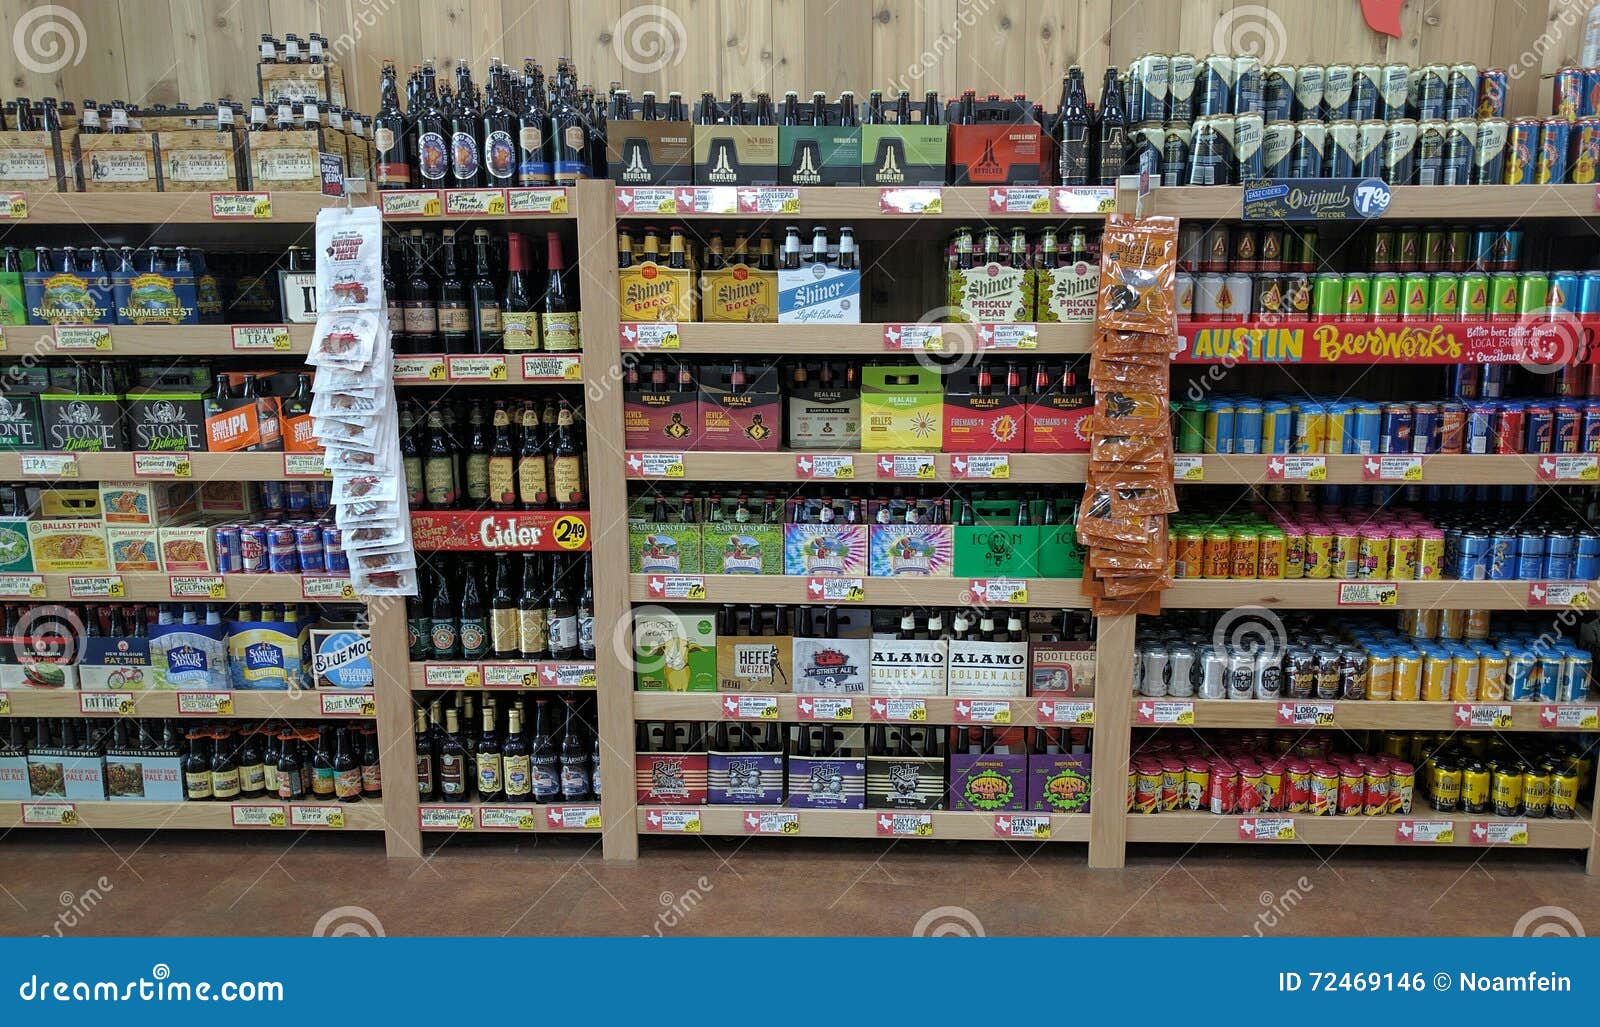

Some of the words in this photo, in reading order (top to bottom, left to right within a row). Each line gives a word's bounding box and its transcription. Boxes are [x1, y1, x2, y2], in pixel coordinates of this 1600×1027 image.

[321, 164, 340, 173] BACON
[325, 172, 343, 185] JERKY
[1284, 185, 1350, 214] Original
[215, 204, 236, 216] Ginger
[626, 280, 674, 304] Shiner
[718, 280, 764, 304] Shiner
[967, 276, 1017, 300] Shiner
[793, 281, 845, 308] Shiner
[1410, 287, 1424, 305] A
[634, 297, 666, 312] BOCK
[725, 298, 757, 312] BOCK
[972, 300, 1012, 309] PRICKLY
[1060, 299, 1096, 308] PRICKL
[32, 308, 108, 317] SUMMERFEST
[119, 307, 193, 317] SUMMERFEST
[793, 310, 818, 322] Light
[818, 308, 846, 320] Blonde
[978, 309, 1006, 317] PEAR
[1066, 308, 1095, 316] PEAR
[1466, 325, 1489, 338] Better
[1490, 326, 1507, 337] beer,
[1508, 326, 1531, 337] Better
[247, 335, 269, 344] IPA
[1191, 327, 1305, 362] AUSTIN
[1313, 324, 1464, 362] BeerWorks
[1471, 339, 1496, 349] LOCAL
[1499, 337, 1539, 347] BREWERS
[1476, 351, 1527, 363] Excellence!
[526, 361, 563, 370] FRAMBOISE
[228, 413, 248, 438] IPA
[52, 424, 116, 449] STONE
[136, 424, 201, 449] STONE
[212, 430, 230, 442] STYLE
[64, 437, 103, 450] Delicious
[149, 436, 187, 450] Delicious
[25, 460, 47, 469] IPA
[42, 522, 76, 530] BALLAST
[77, 521, 101, 530] POINT
[412, 516, 433, 528] enry
[480, 516, 543, 548] Cider
[656, 525, 686, 533] ARNOLD
[715, 524, 739, 532] SAINT
[739, 524, 769, 533] ARNOLD
[1230, 562, 1254, 576] IPA
[1342, 591, 1369, 600] BLONDE
[171, 652, 204, 662] SAMUEL
[249, 648, 280, 659] SAMUEL
[315, 651, 347, 674] BLUE
[349, 640, 372, 659] MOO
[739, 650, 769, 665] HEFE
[872, 652, 944, 663] ALAMO
[952, 653, 1024, 664] ALAMO
[1036, 651, 1096, 662] BOOTLEGGE
[124, 657, 145, 665] TIRE
[174, 659, 202, 668] ADAMS
[252, 655, 279, 665] ADAMS
[739, 665, 770, 674] WEIZEN
[871, 668, 916, 678] GOLDEN
[922, 669, 944, 679] ALE
[951, 670, 997, 680] GOLDEN
[1003, 671, 1024, 681] ALE
[339, 674, 373, 682] WHITE
[85, 697, 101, 707] FAT
[102, 697, 120, 707] TIRE
[325, 701, 343, 712] BLUE
[344, 696, 366, 710] MOON
[1472, 709, 1502, 718] MONARCH
[652, 760, 681, 777] Rahr
[728, 761, 757, 777] Rahr
[810, 765, 838, 782] Rahr
[889, 764, 918, 782] Rahr
[971, 777, 1007, 794] STASH
[1050, 777, 1085, 794] STASH
